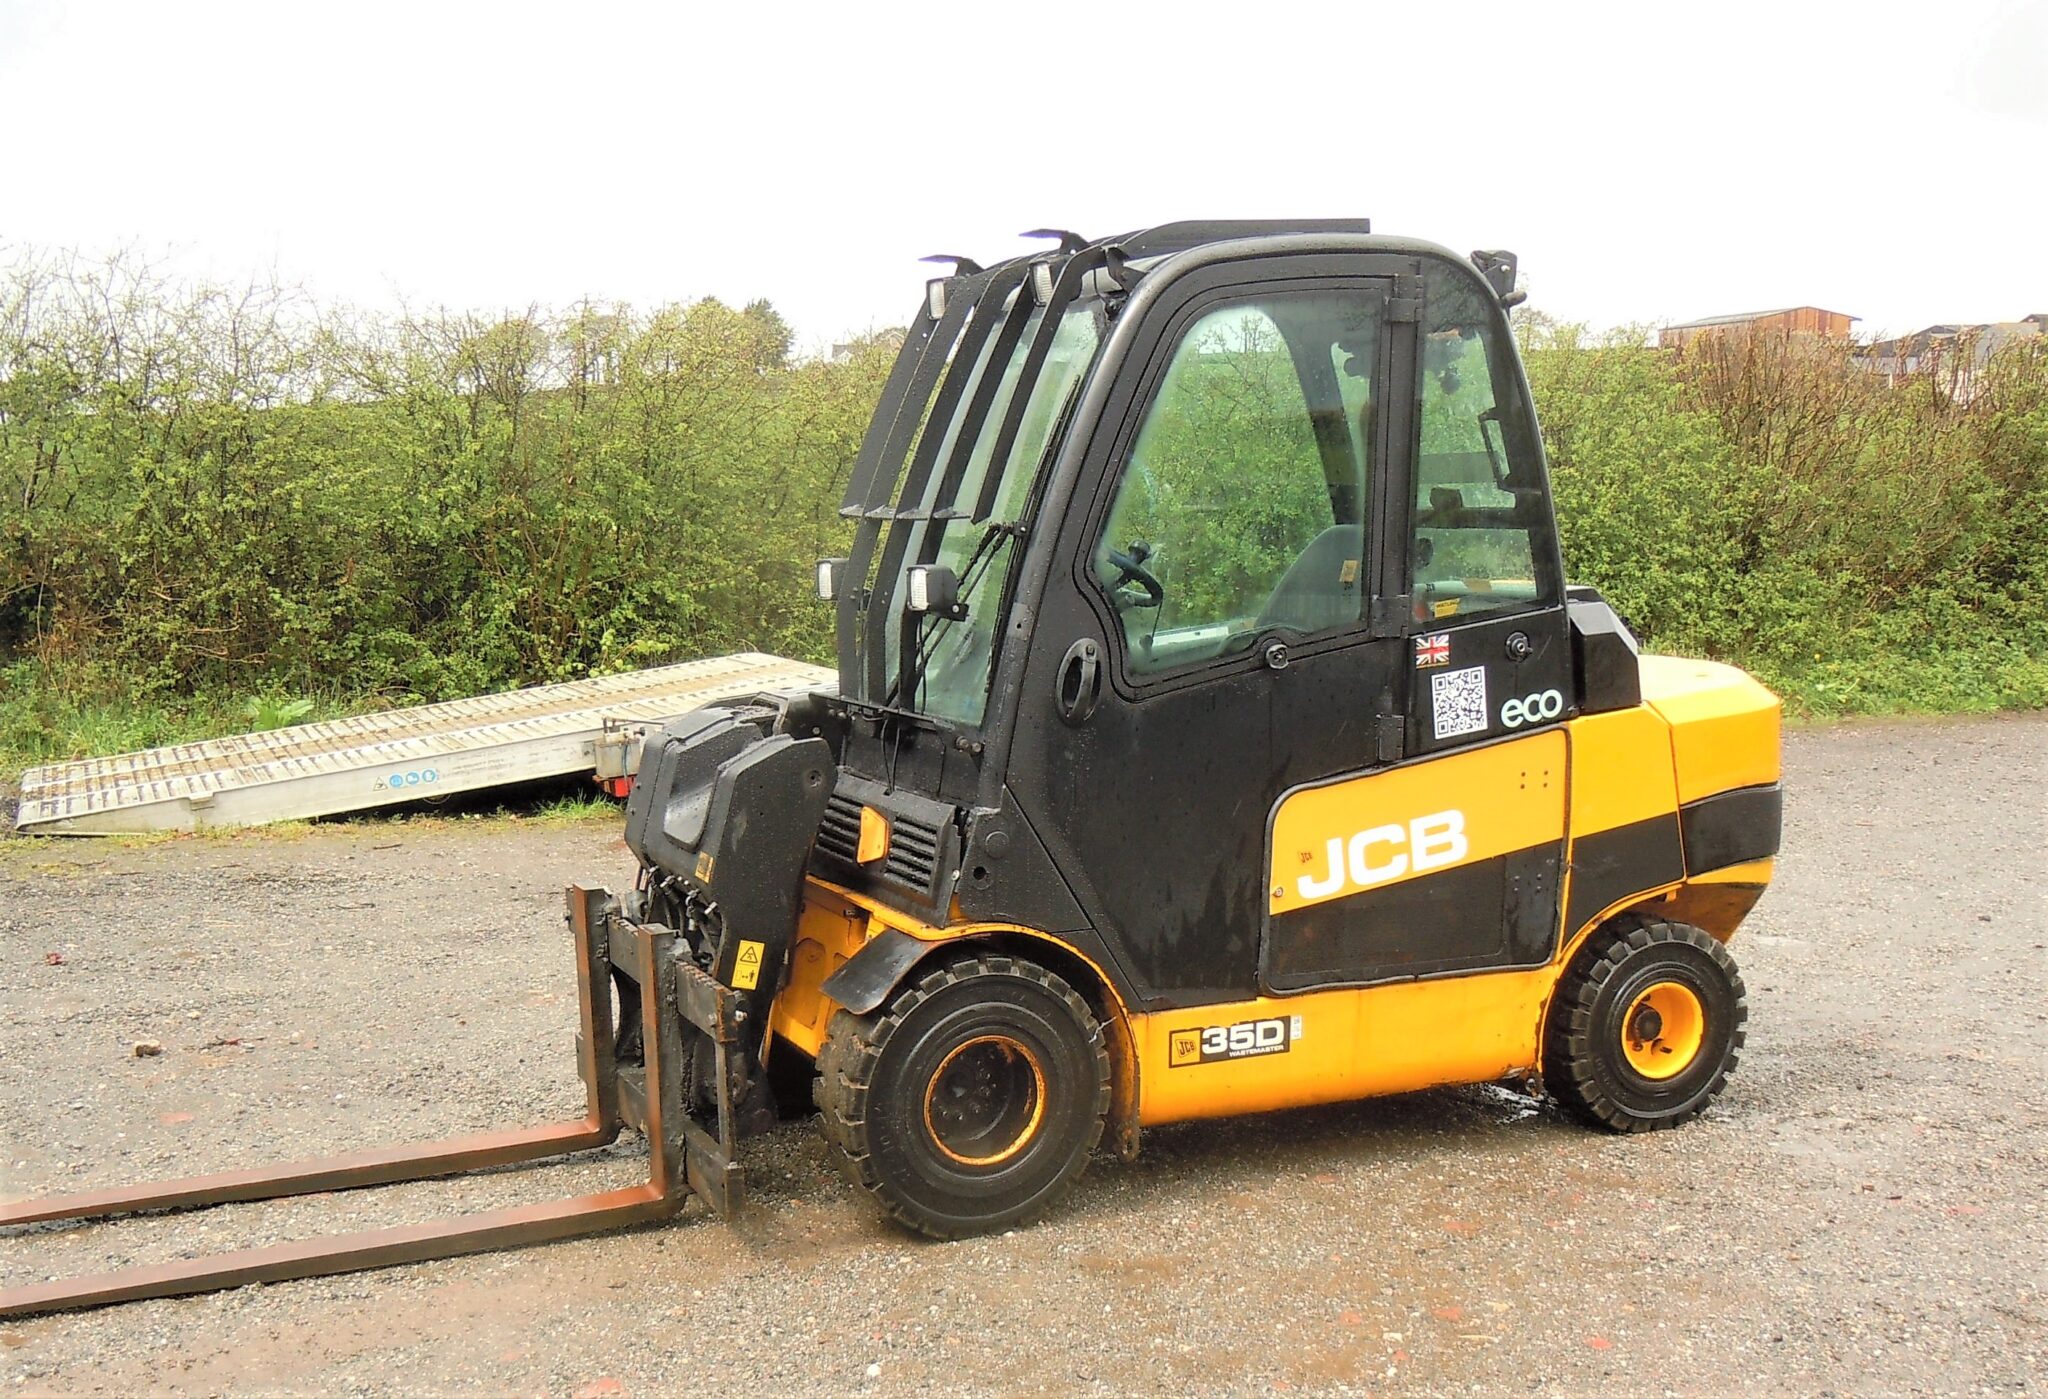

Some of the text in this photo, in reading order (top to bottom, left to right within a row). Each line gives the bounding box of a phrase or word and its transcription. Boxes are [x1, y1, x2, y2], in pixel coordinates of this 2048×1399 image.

[1501, 689, 1563, 728] eco
[1296, 809, 1468, 899] JCB
[1180, 1041, 1195, 1055] JCB
[1201, 1020, 1285, 1055] 35D
[1229, 1045, 1285, 1057] WASTEMASTER
